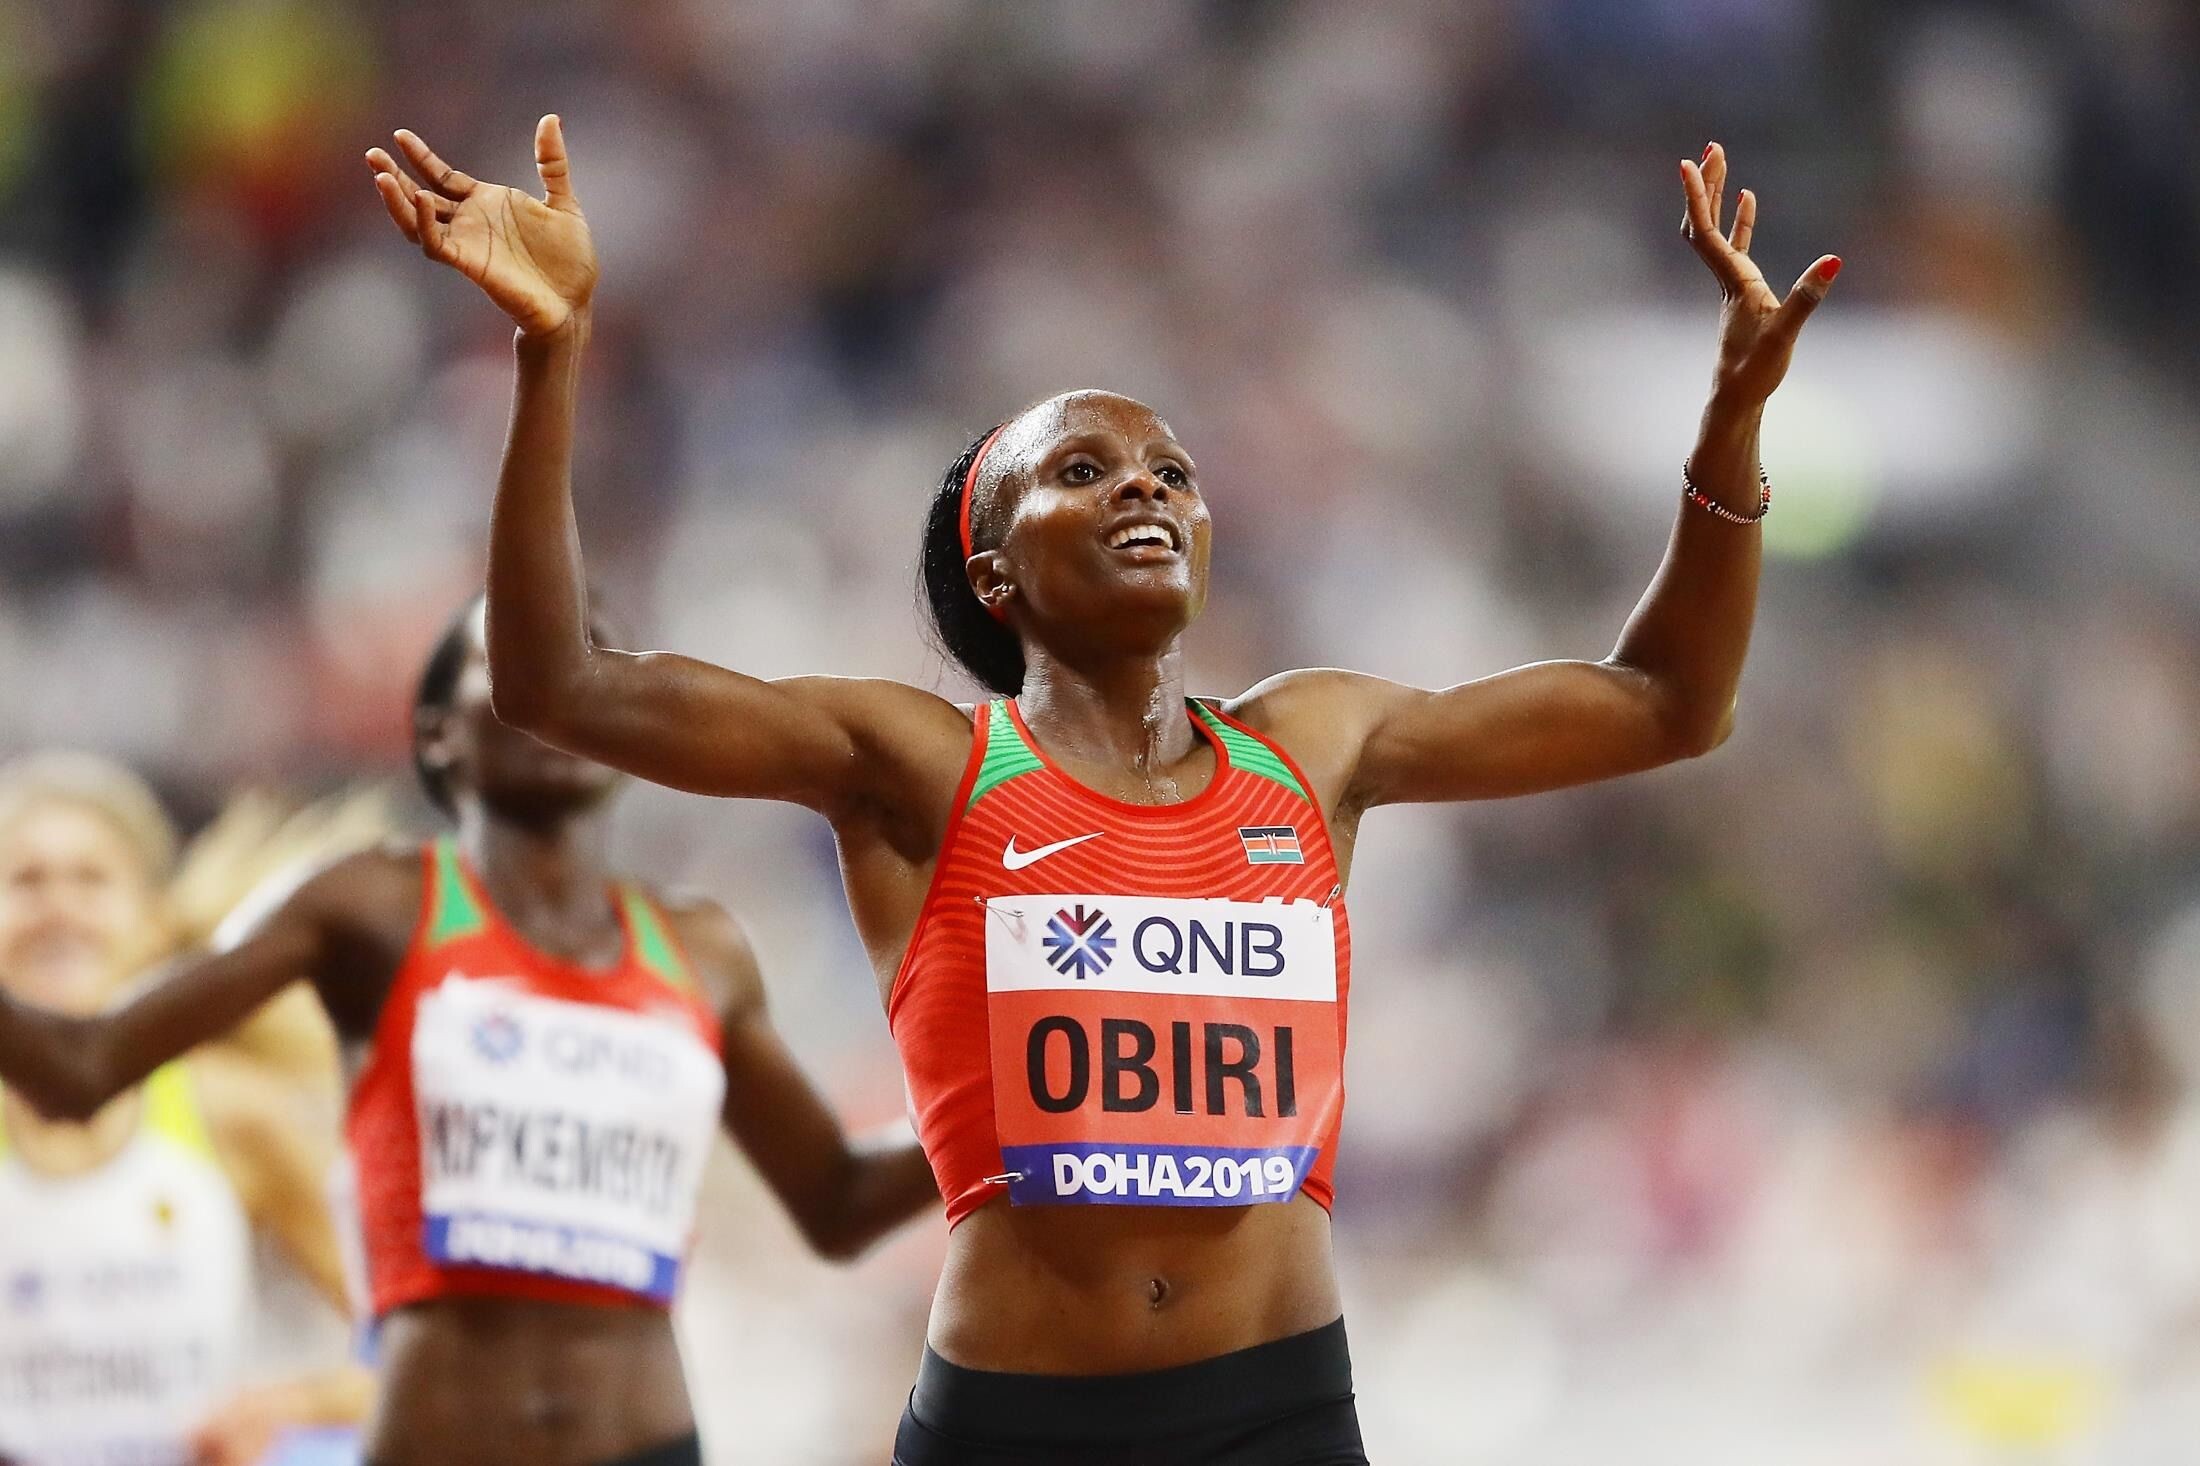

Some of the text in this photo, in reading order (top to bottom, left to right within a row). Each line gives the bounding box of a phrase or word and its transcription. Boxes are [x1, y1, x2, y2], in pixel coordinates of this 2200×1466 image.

[1132, 915, 1286, 978] QNB
[1026, 1015, 1297, 1119] OBIRI
[1052, 1152, 1295, 1198] DOHA2019
